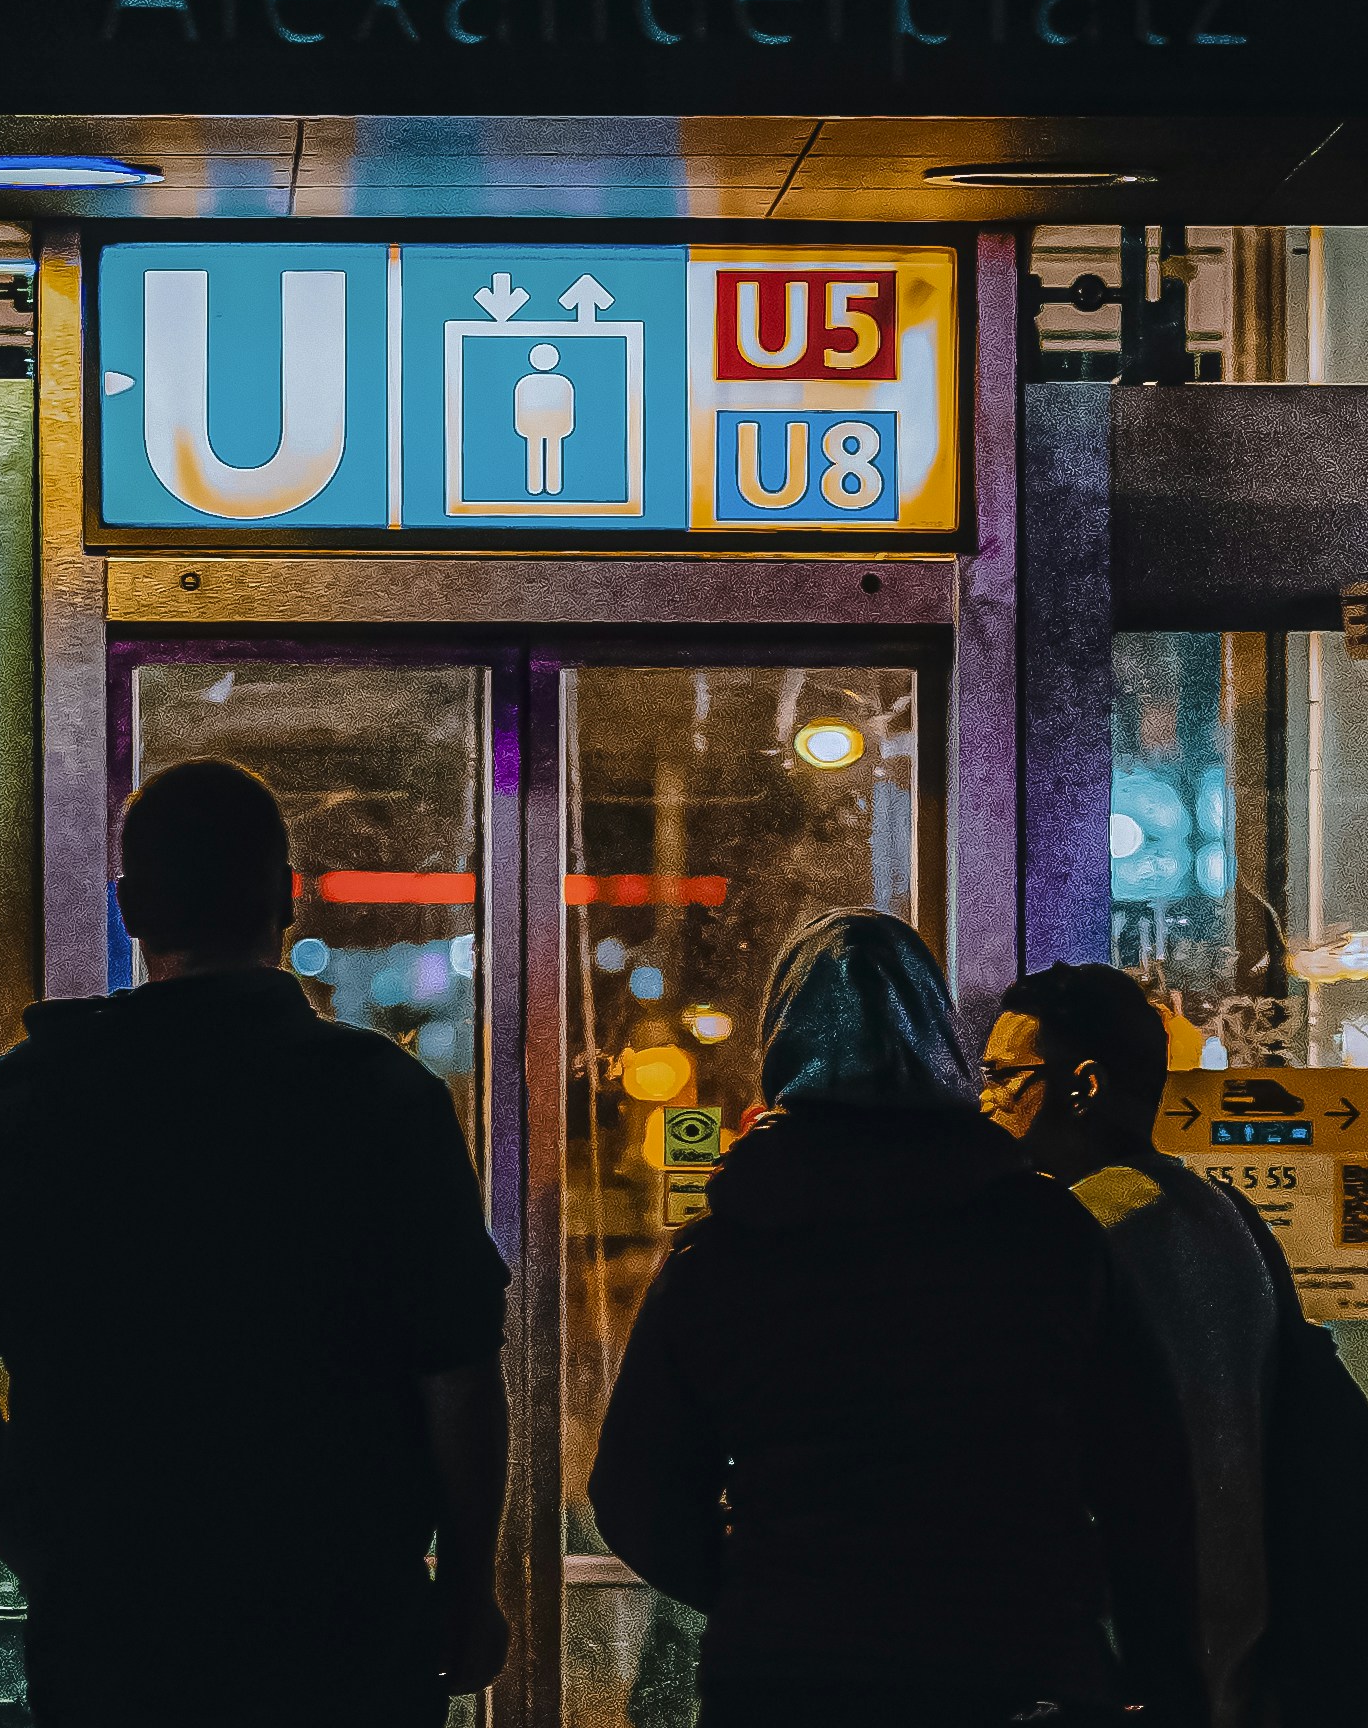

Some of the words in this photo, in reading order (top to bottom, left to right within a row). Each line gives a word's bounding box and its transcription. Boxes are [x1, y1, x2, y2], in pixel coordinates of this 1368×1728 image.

[734, 280, 883, 370] U5
[143, 269, 347, 521] U
[734, 419, 885, 510] U8
[1244, 1166, 1259, 1189] 5
[1265, 1166, 1297, 1189] 55
